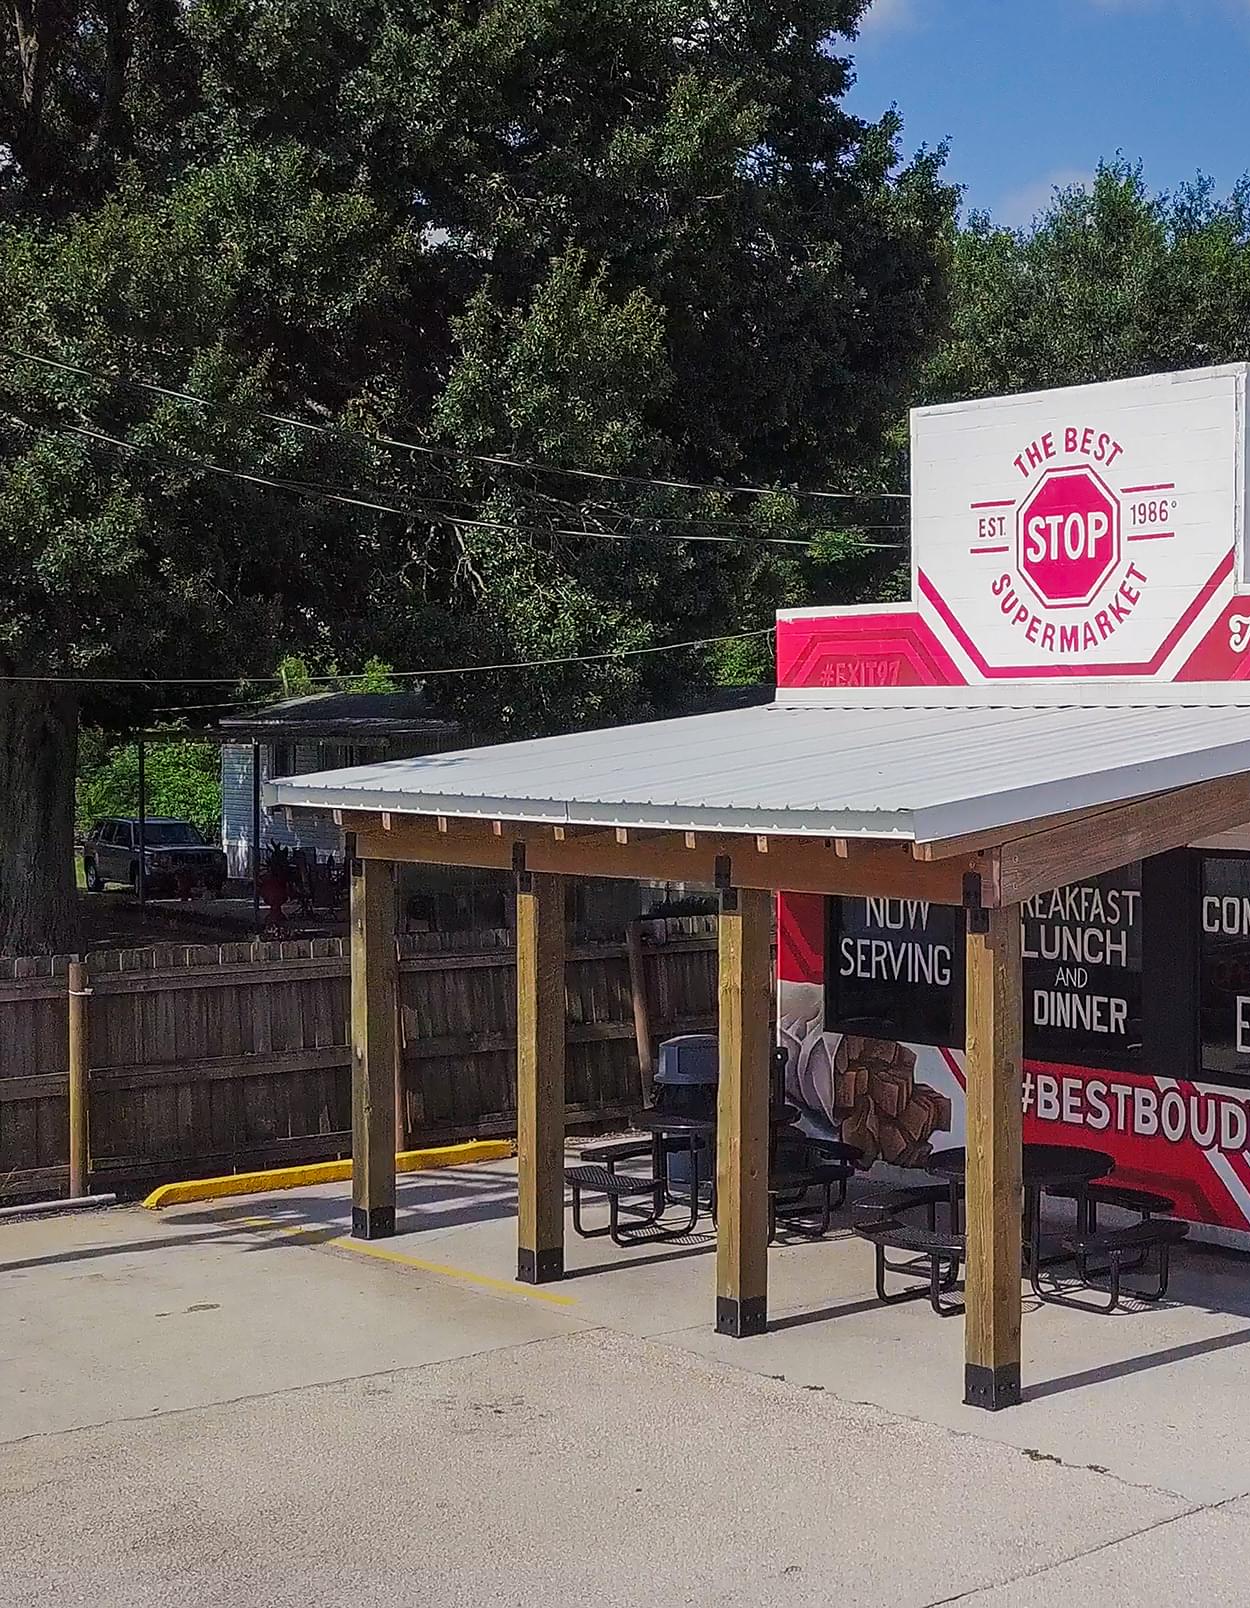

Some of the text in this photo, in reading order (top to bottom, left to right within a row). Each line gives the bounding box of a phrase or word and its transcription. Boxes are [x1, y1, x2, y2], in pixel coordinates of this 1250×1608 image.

[1013, 427, 1124, 478] THE BEST
[978, 516, 1007, 538] EST.
[1026, 510, 1109, 563] STOP
[991, 562, 1148, 653] SUPERMARKET
[865, 896, 930, 932] NOW
[840, 937, 952, 986] SERVING
[1020, 923, 1127, 967] LUNCH
[1054, 966, 1089, 989] AND
[1033, 989, 1128, 1035] DINNER
